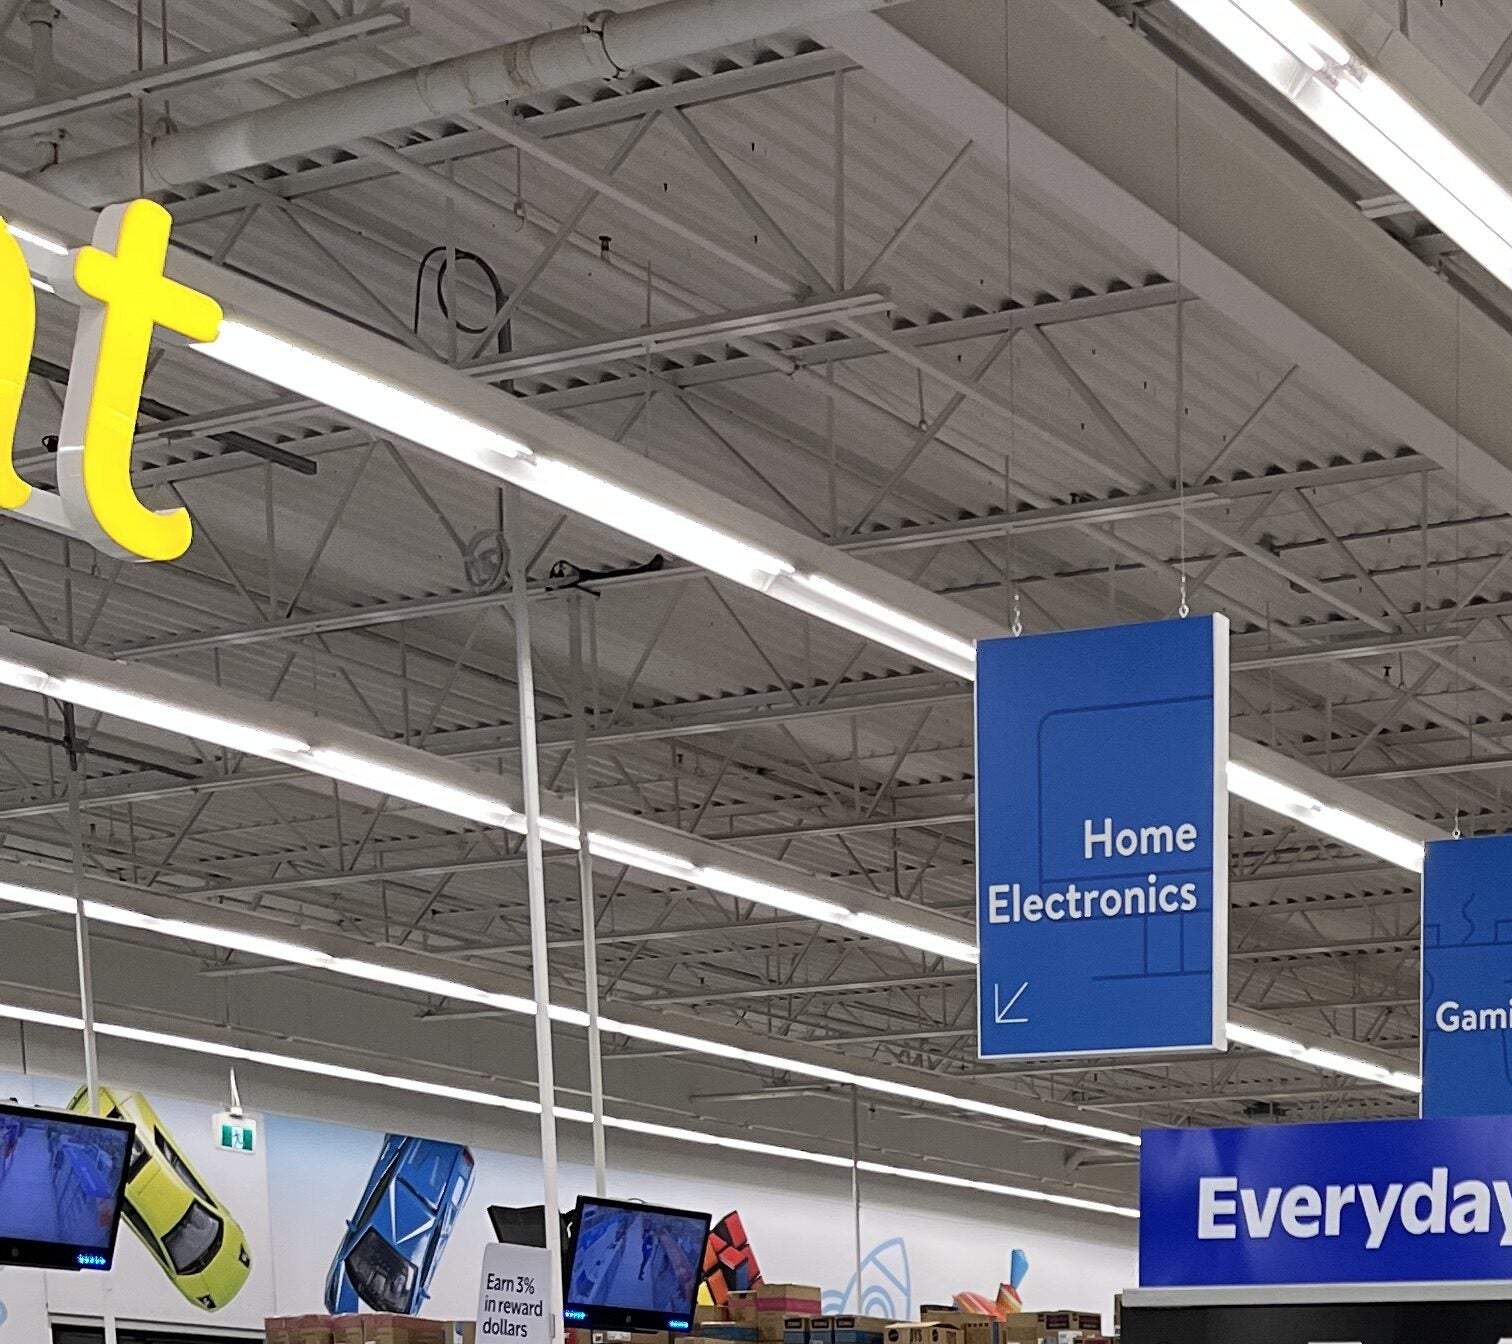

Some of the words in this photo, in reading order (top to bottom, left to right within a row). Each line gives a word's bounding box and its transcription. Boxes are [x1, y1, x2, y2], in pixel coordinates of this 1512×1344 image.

[1083, 817, 1198, 860] Home
[987, 873, 1198, 925] Electronics
[486, 1273, 514, 1292] Earn
[516, 1276, 535, 1295] 3%
[484, 1295, 496, 1312] in
[499, 1299, 543, 1317] reward
[483, 1317, 528, 1337] dollars
